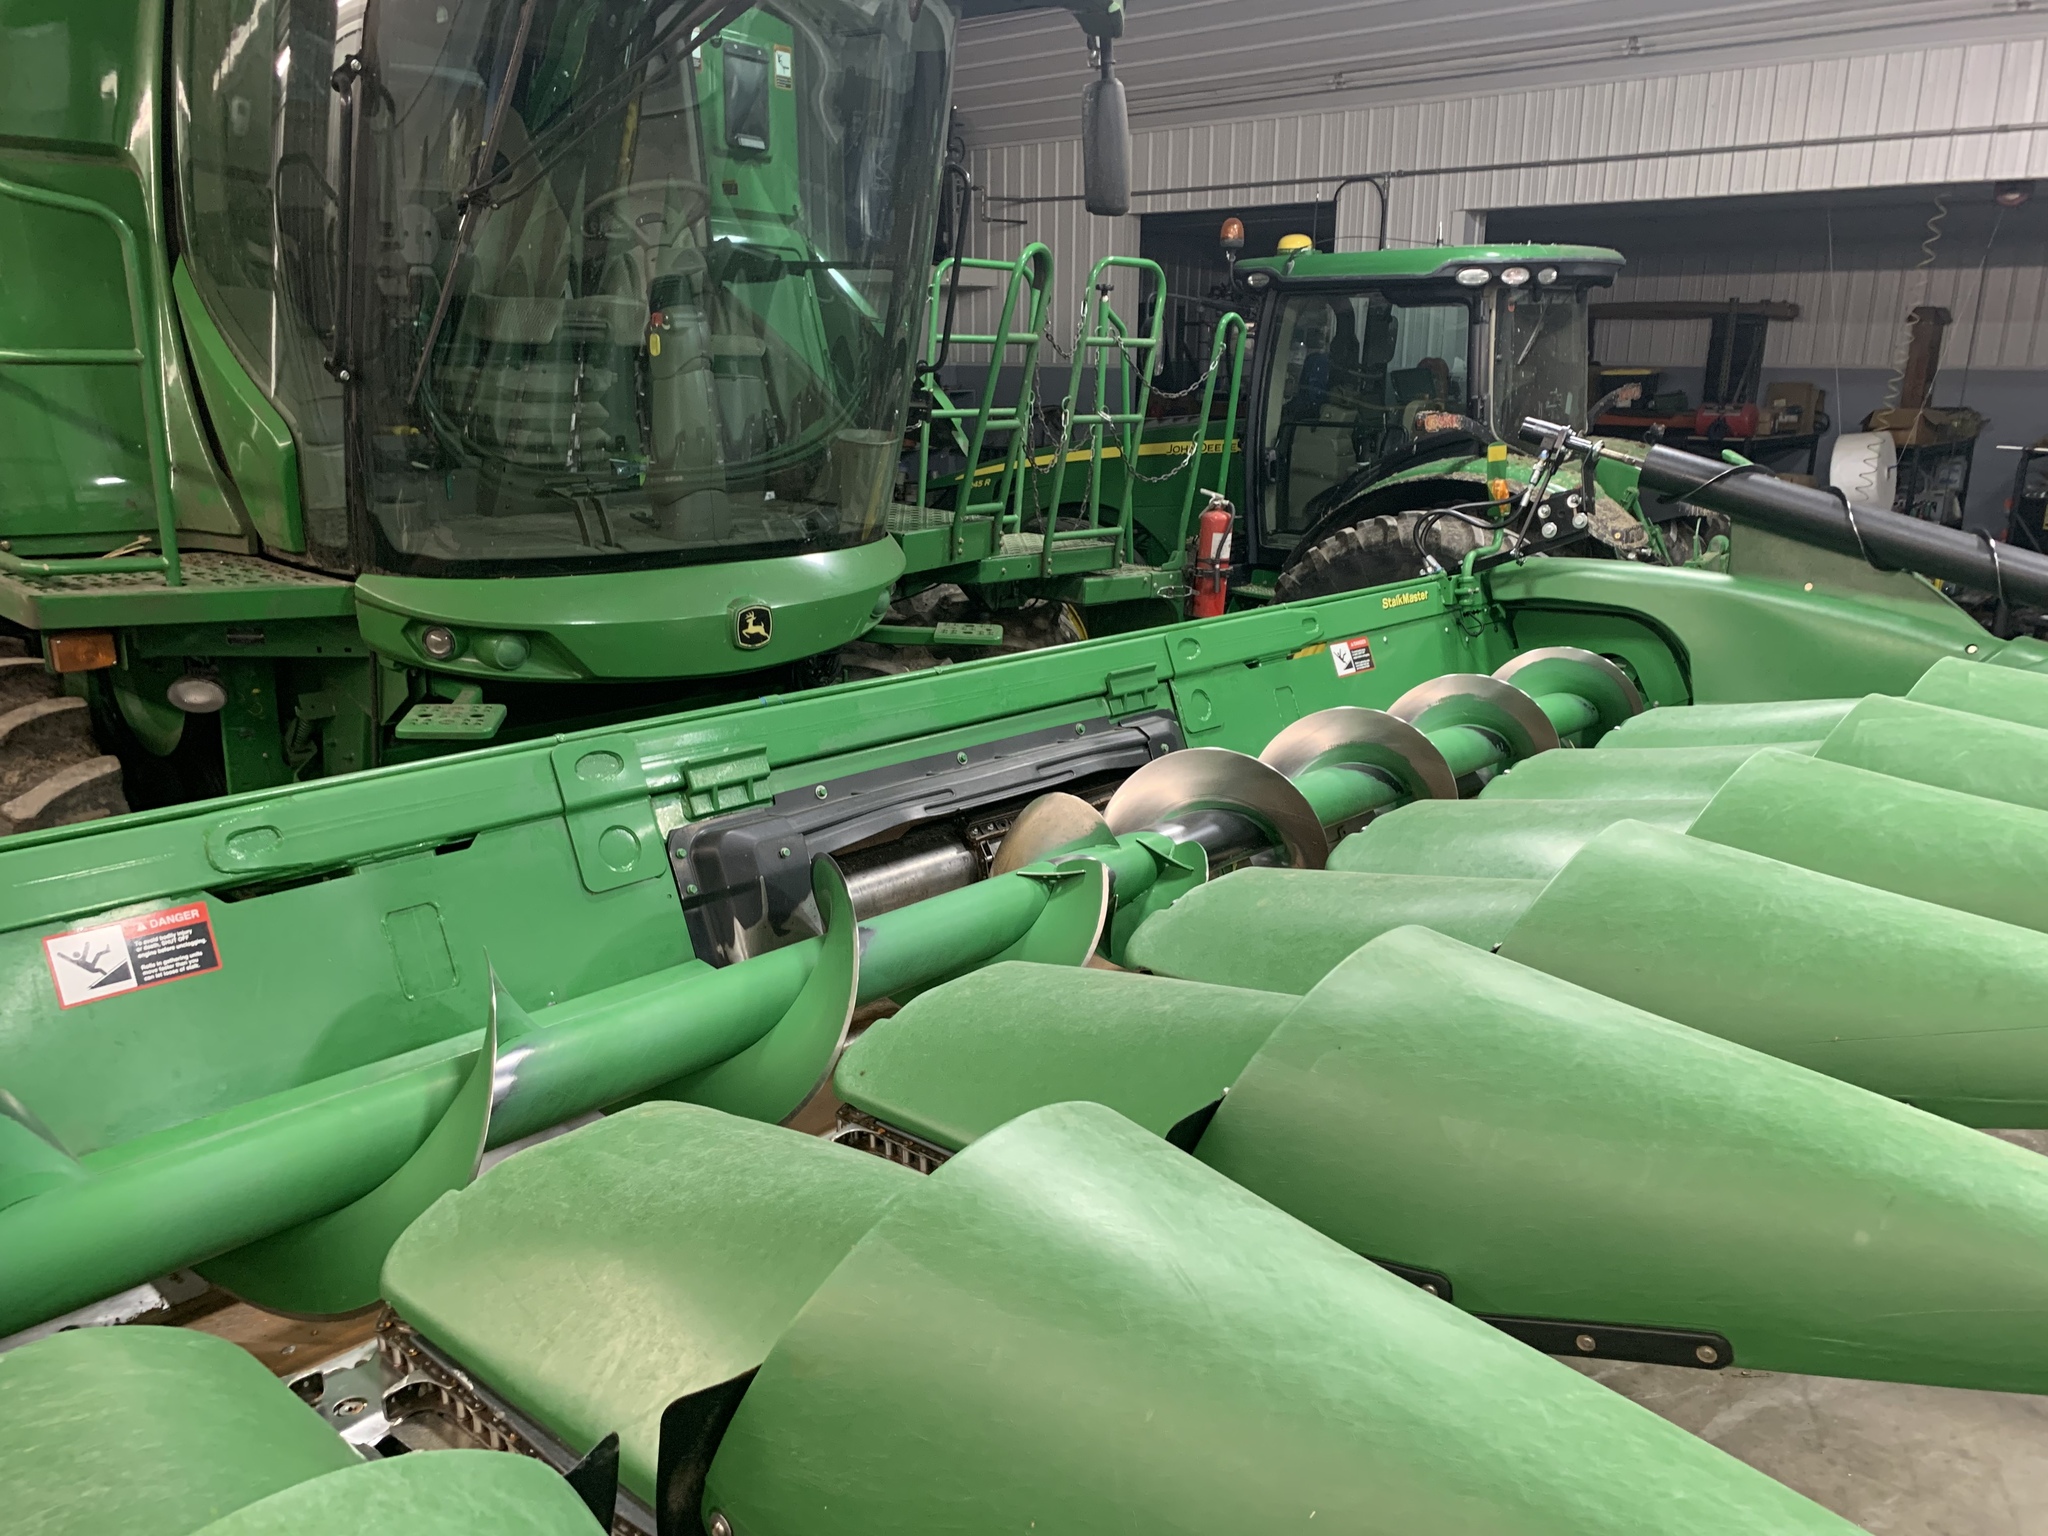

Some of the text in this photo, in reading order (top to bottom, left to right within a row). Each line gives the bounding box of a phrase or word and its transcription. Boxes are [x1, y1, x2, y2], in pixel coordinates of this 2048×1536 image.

[1200, 443, 1237, 453] DEEE
[1382, 590, 1428, 609] StalkMaster
[149, 909, 200, 928] DANGER
[143, 936, 158, 944] avoid
[177, 929, 192, 937] injury
[161, 937, 176, 946] SHUT
[178, 934, 189, 942] OFF
[137, 950, 157, 958] engine
[157, 945, 175, 954] before
[163, 954, 188, 966] gathering
[142, 967, 158, 975] move
